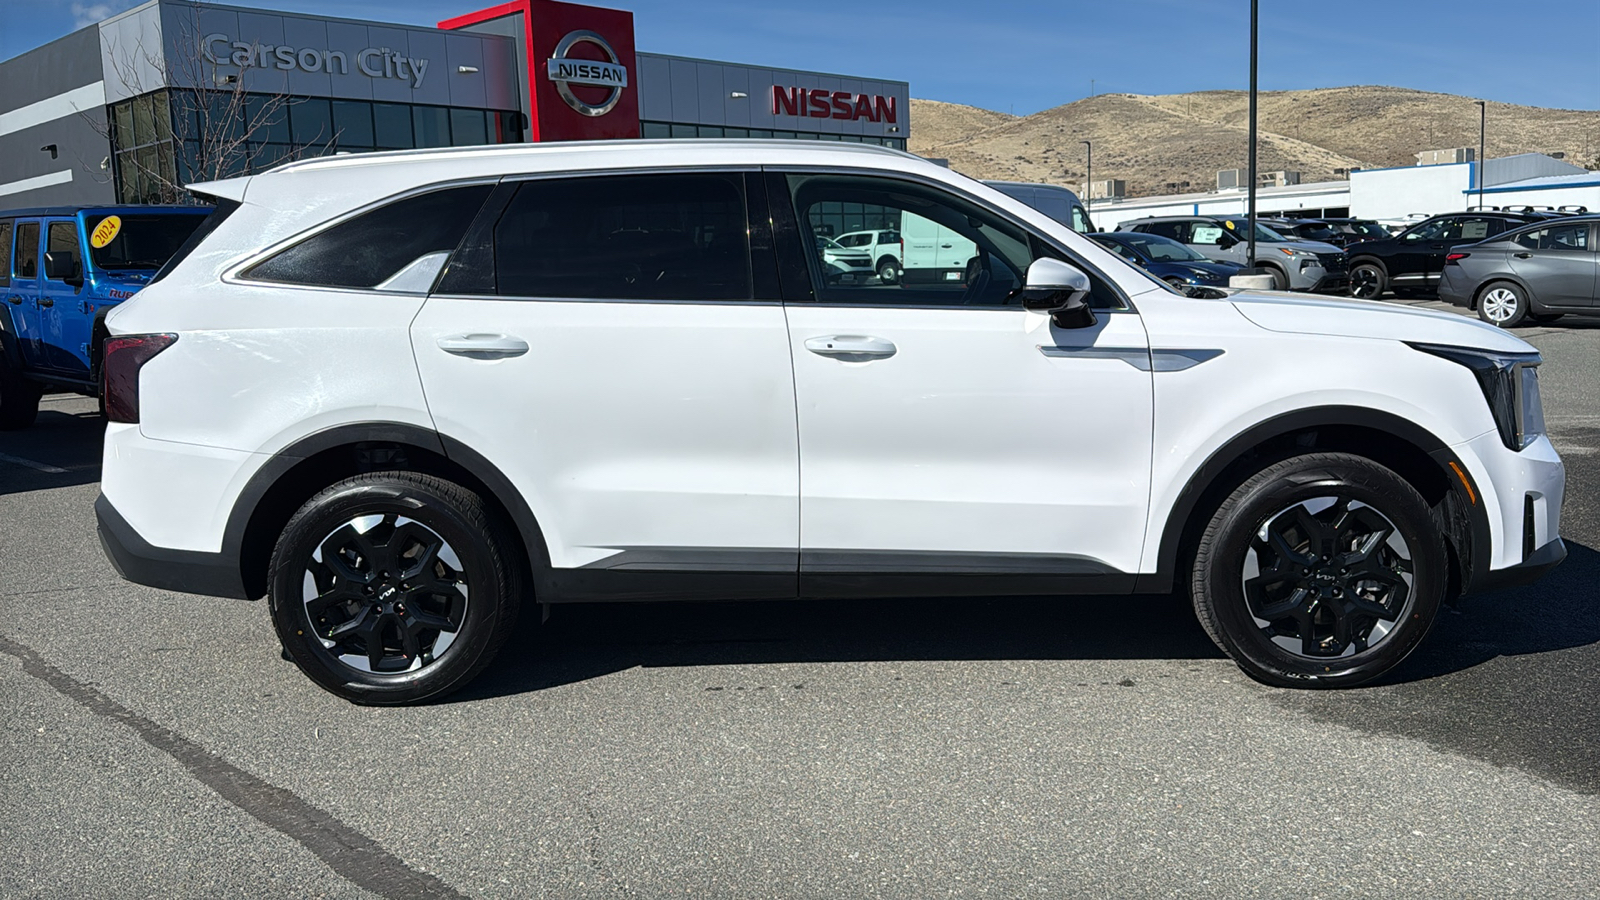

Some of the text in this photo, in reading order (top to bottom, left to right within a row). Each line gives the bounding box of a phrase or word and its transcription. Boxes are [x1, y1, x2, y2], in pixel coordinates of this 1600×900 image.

[201, 33, 429, 89] Carson City
[558, 63, 622, 82] NISSAN
[772, 85, 897, 124] NISSAN
[95, 219, 116, 245] 2024
